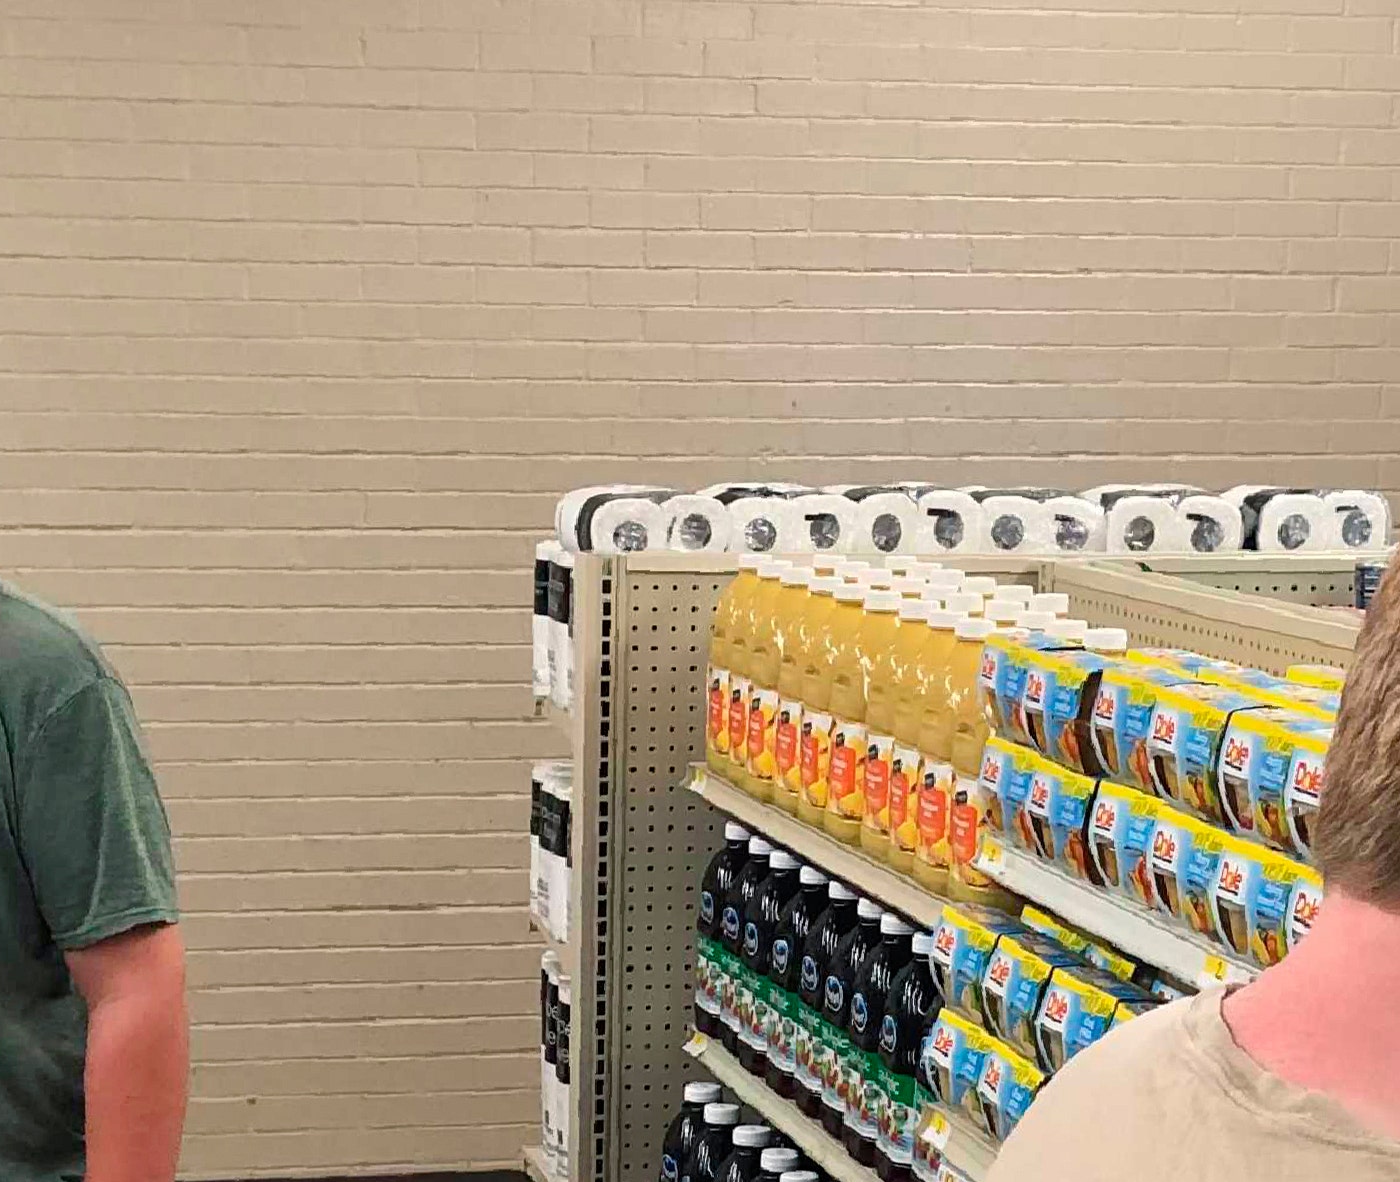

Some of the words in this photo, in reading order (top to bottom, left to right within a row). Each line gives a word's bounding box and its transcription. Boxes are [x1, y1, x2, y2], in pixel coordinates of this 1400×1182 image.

[1154, 713, 1176, 740] Dole
[1225, 738, 1250, 766] Dole
[1295, 760, 1326, 792] Dole
[1153, 829, 1176, 858] Dole
[1219, 861, 1243, 890] Dole
[1045, 990, 1069, 1018] Dole
